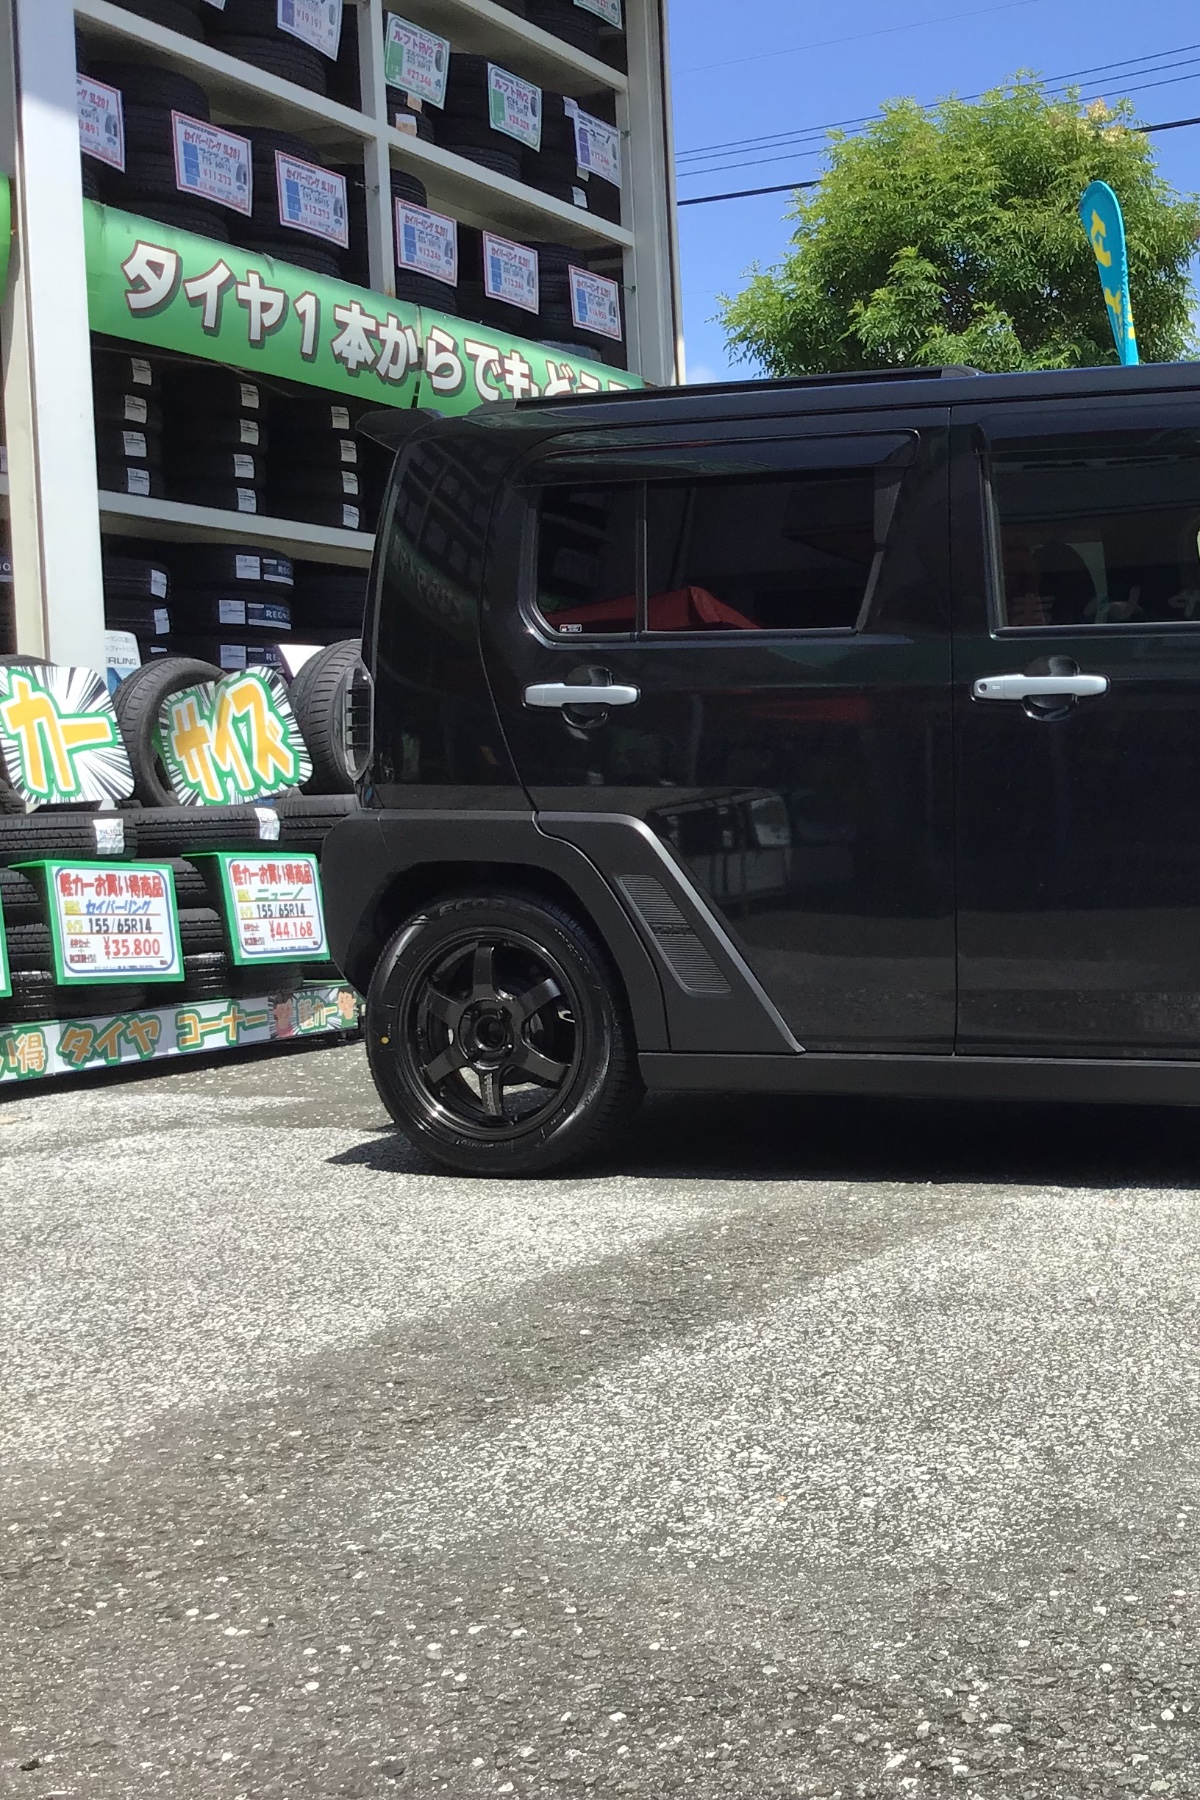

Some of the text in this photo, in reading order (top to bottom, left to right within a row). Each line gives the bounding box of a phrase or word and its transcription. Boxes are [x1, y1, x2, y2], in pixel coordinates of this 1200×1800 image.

[121, 240, 630, 401] タイヤ1本からでもど
[105, 656, 137, 665] RLING
[4, 673, 295, 800] カー サイズ
[255, 886, 304, 901] ニューノ
[86, 899, 152, 915] セイバーリング
[256, 902, 306, 918] 155/65R14
[89, 918, 152, 933] 155/65R14
[60, 1015, 161, 1063] タイヤ
[176, 1004, 270, 1048] コーナー
